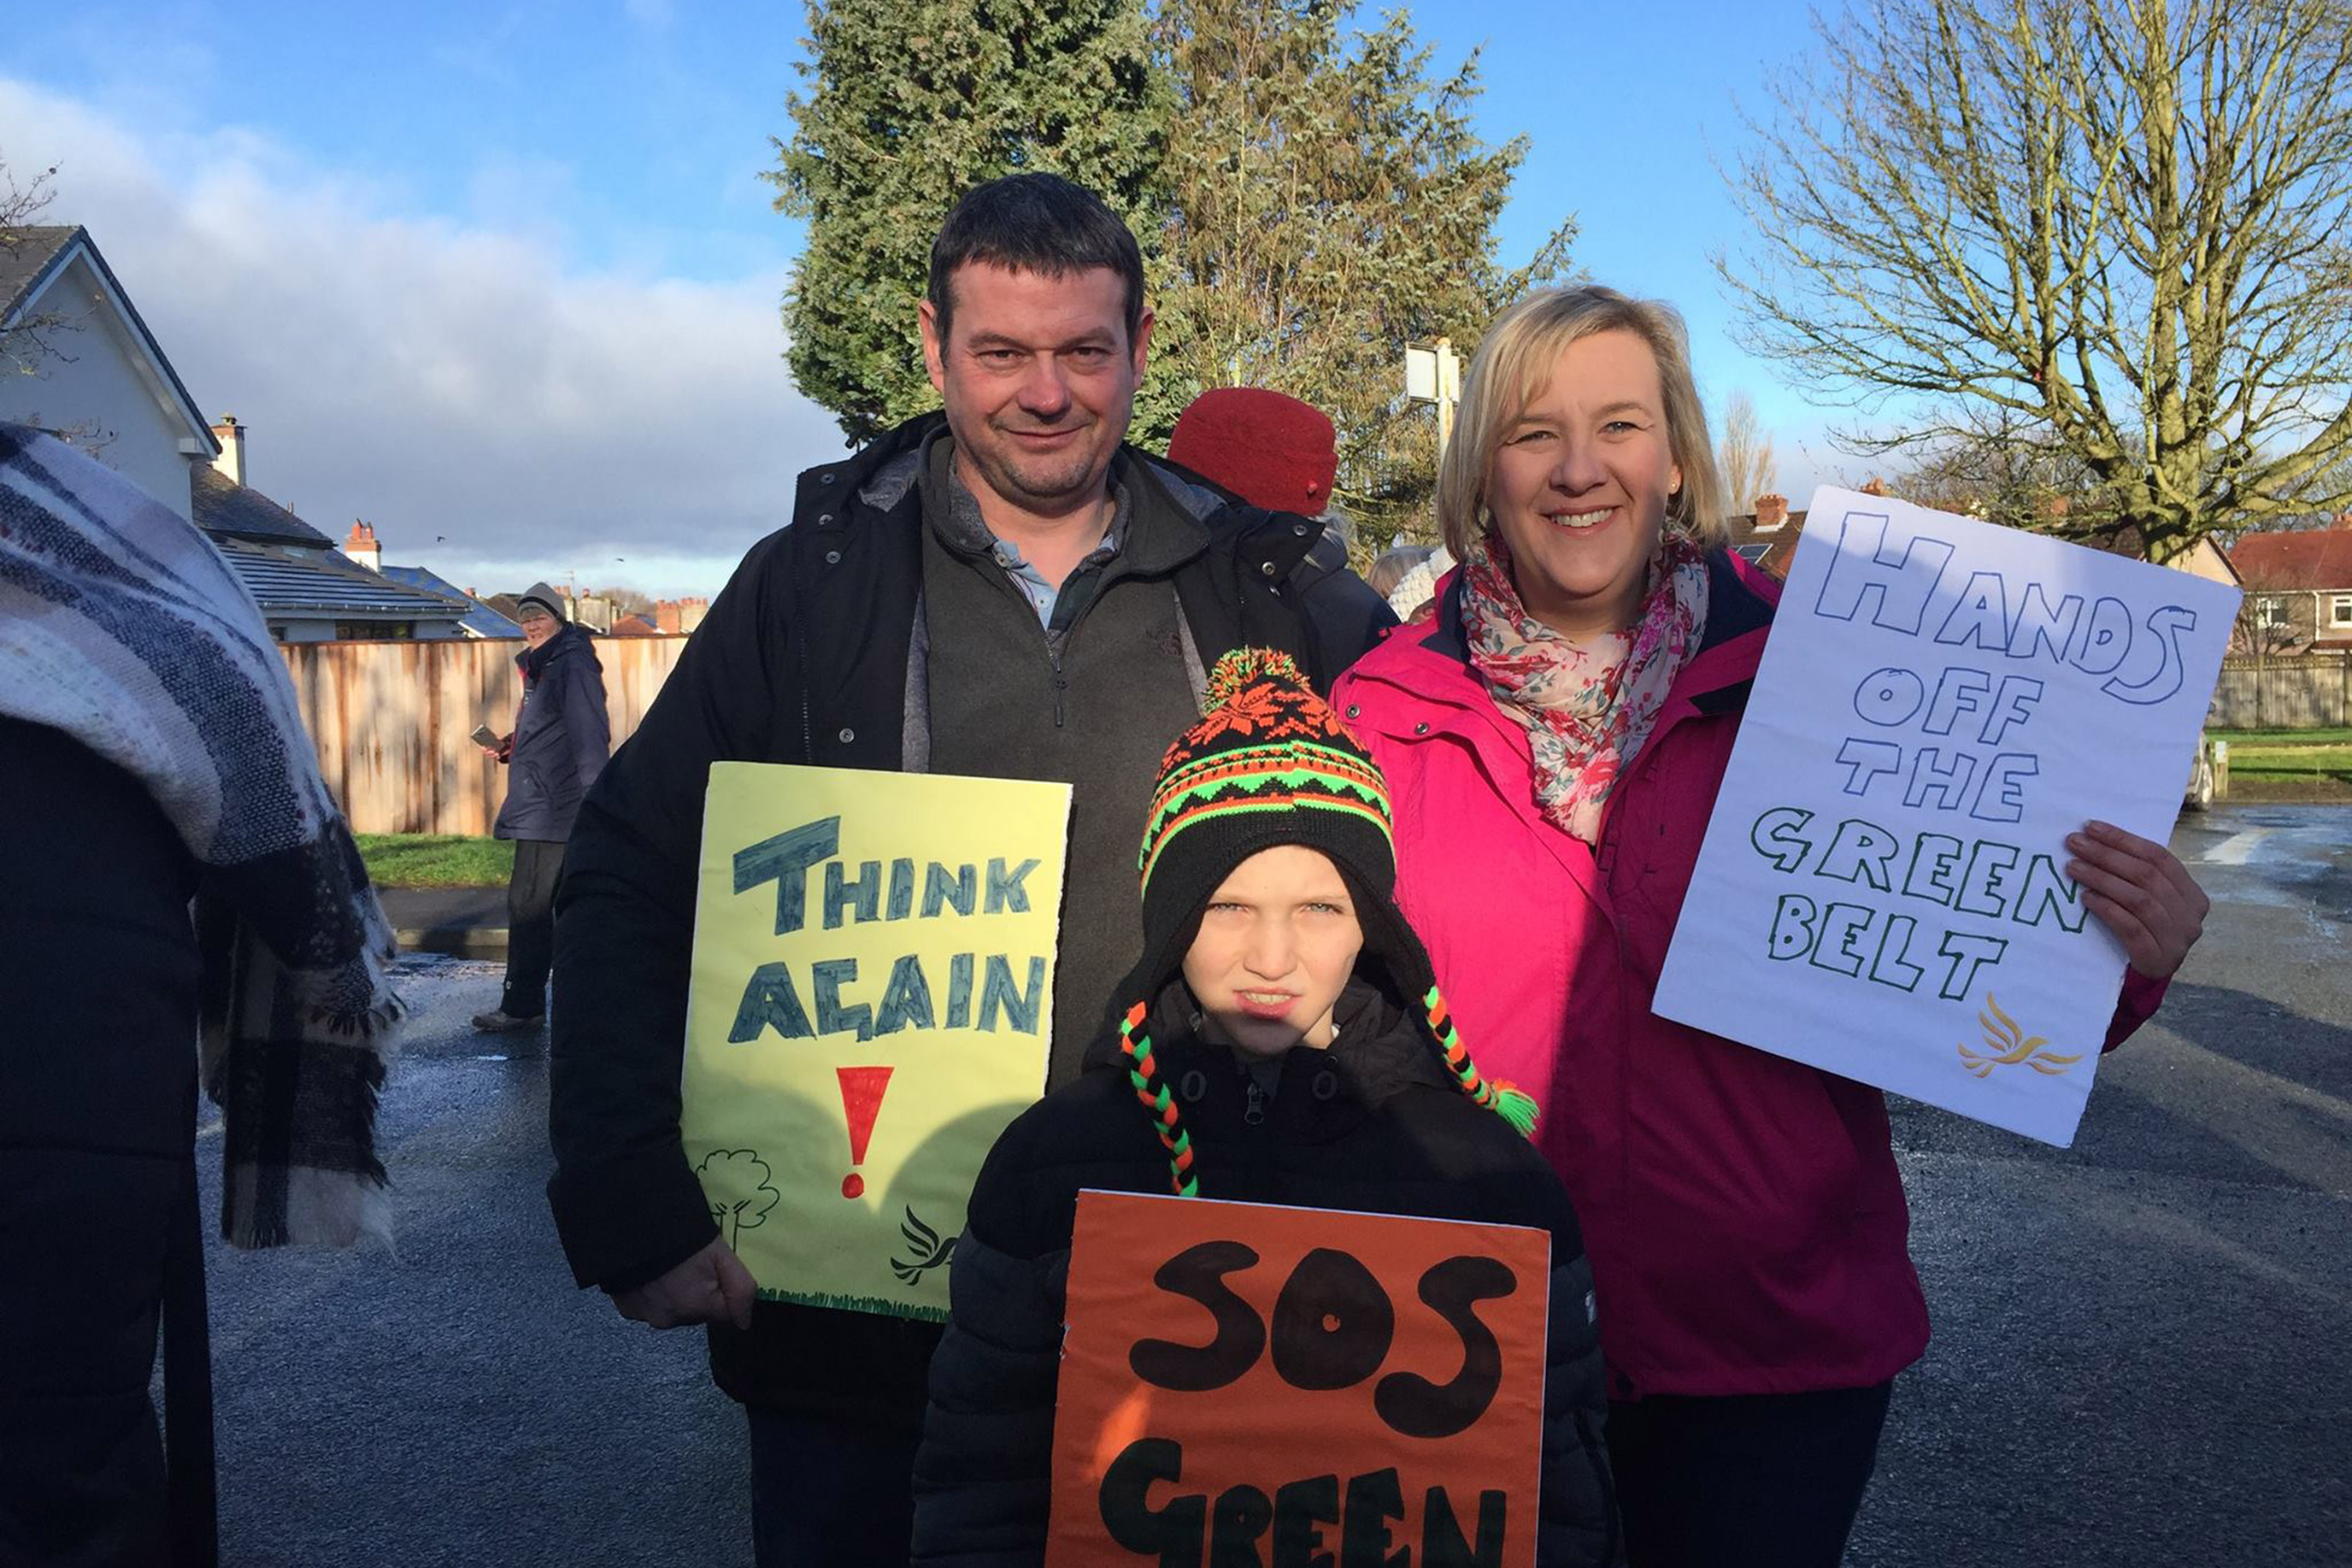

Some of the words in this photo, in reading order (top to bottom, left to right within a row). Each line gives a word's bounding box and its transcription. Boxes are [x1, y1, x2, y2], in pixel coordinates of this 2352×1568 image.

[1814, 511, 2197, 706] HANDS
[1853, 666, 2045, 745] OFF
[1835, 737, 2040, 823] THE
[733, 815, 1044, 936] THINK
[1751, 807, 2090, 934] GREEN
[728, 953, 1047, 1044] AGAIN
[1768, 894, 2009, 1001] BELT
[836, 1066, 895, 1200] !
[1128, 1240, 1518, 1438] SOS
[1098, 1436, 1508, 1568] GREEN
